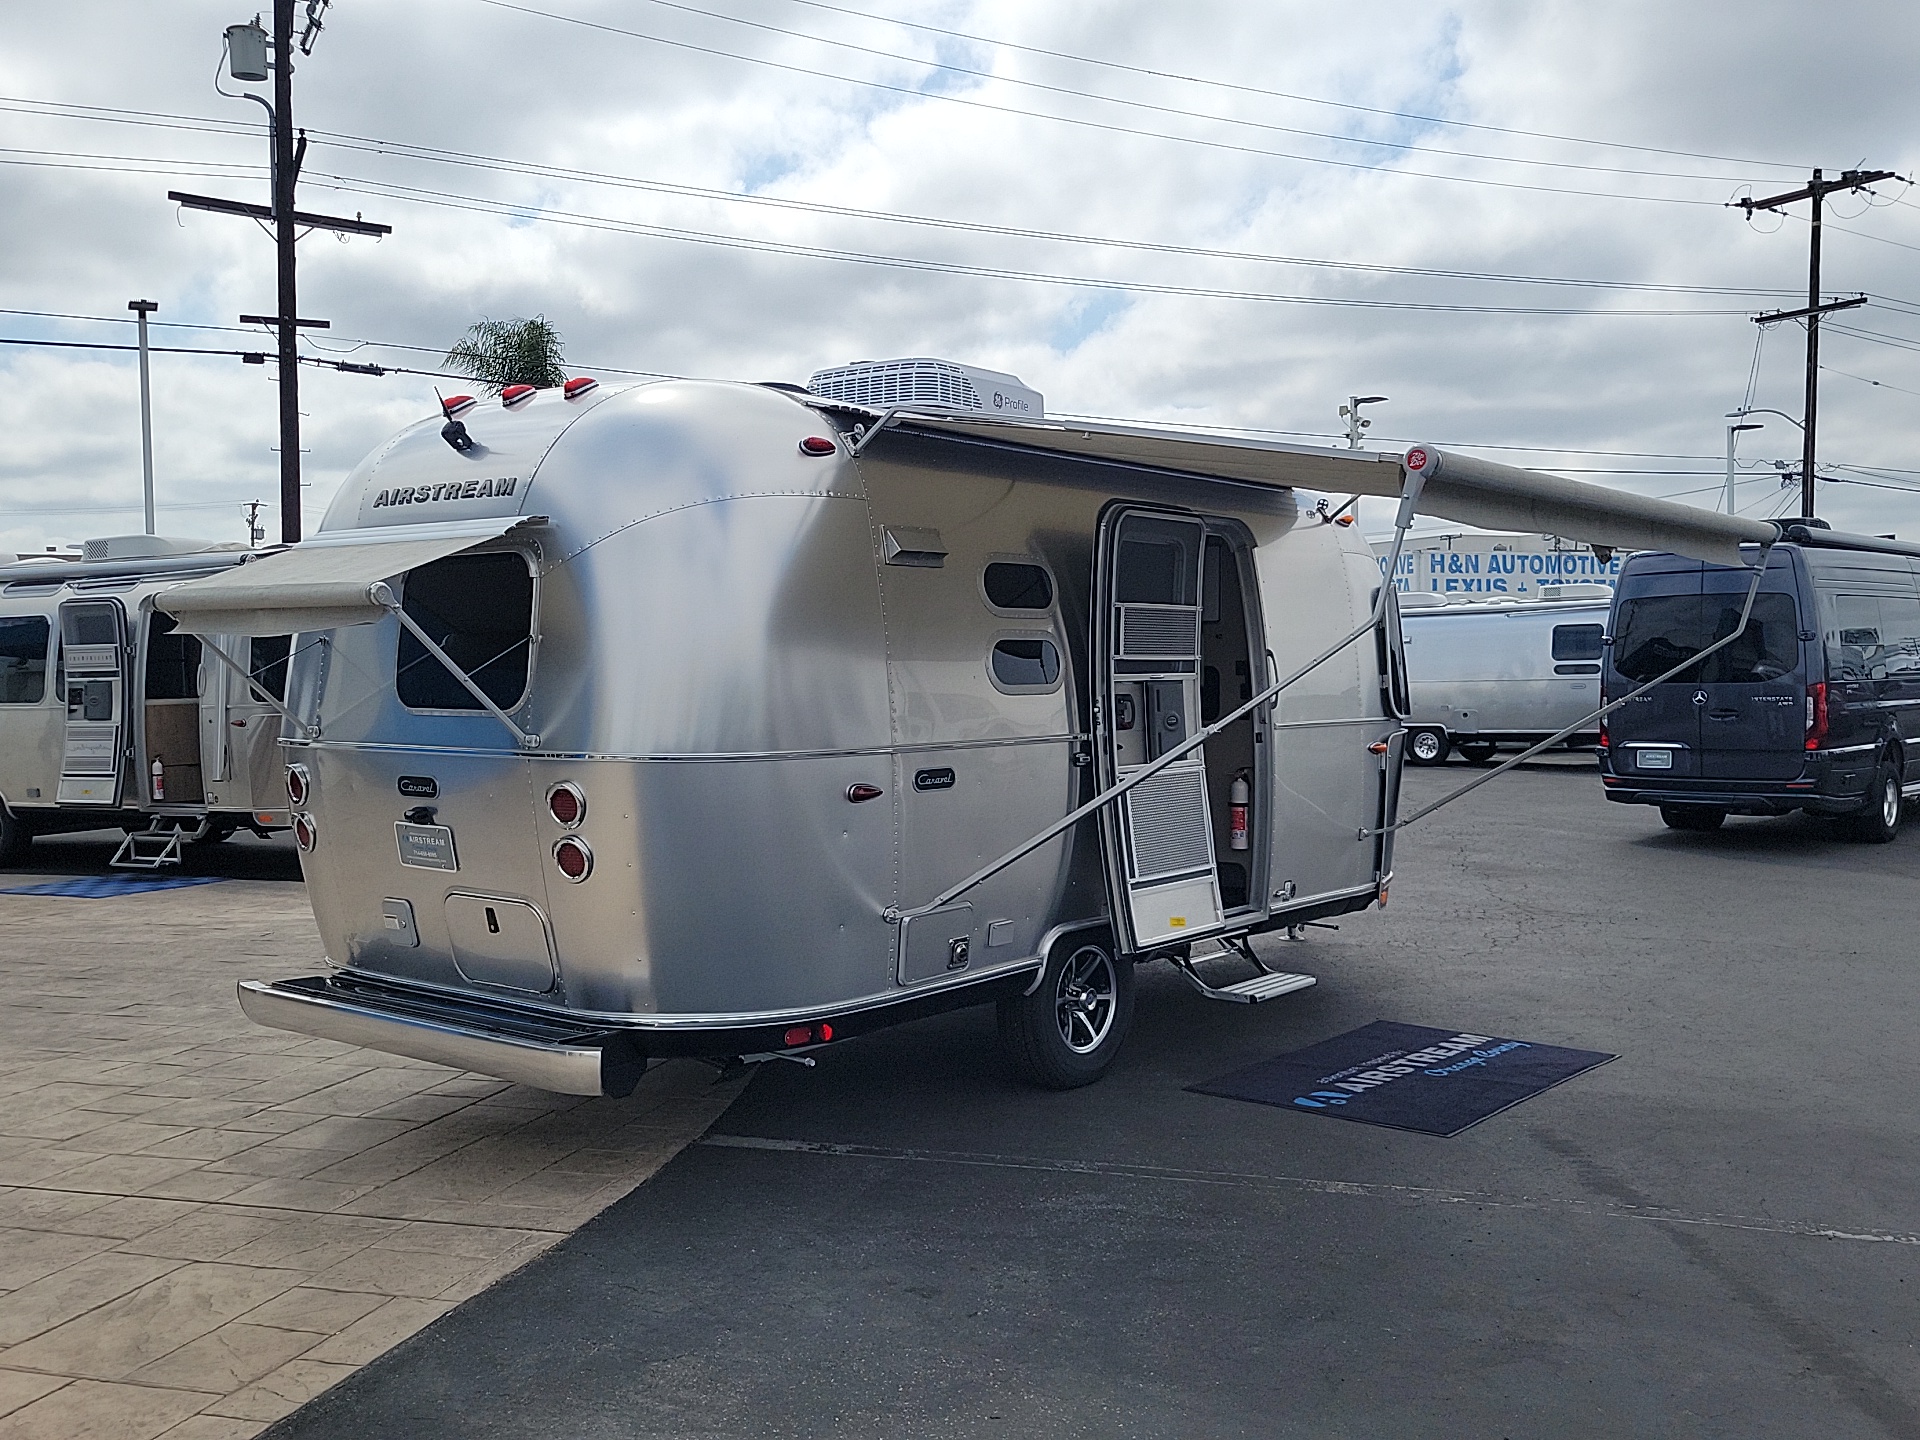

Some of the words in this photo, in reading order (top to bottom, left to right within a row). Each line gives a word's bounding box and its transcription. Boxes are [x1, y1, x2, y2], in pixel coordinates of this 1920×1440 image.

[372, 477, 518, 508] AIRSTREAM
[1430, 553, 1480, 575] H&N
[1487, 553, 1621, 576] AUTOMOTIVE
[409, 835, 445, 846] AIRSTREAM
[1335, 1033, 1494, 1092] AIRSTREAM
[1424, 1056, 1487, 1077] Orange
[1472, 1040, 1532, 1058] County
